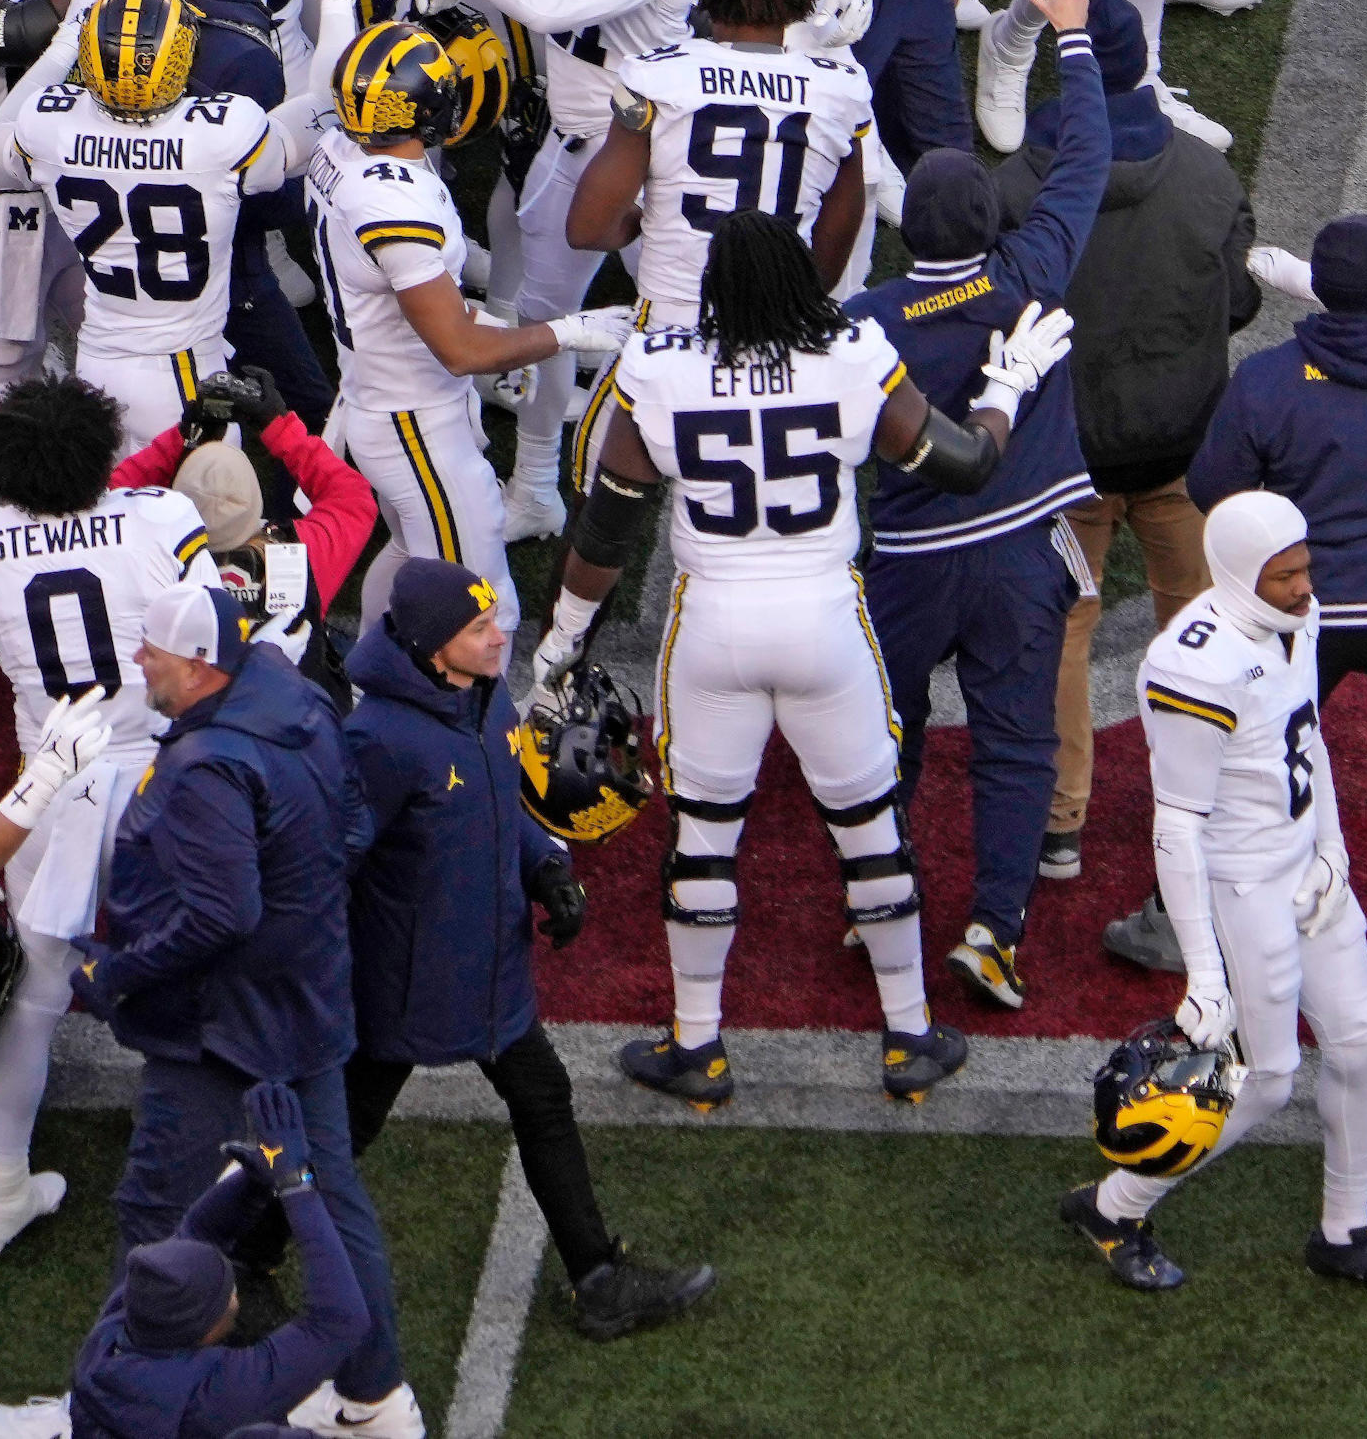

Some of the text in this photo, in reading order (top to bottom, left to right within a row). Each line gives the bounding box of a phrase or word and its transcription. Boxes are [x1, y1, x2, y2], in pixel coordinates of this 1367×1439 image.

[700, 67, 811, 106] BRANDT
[64, 134, 185, 171] JOHNSON
[681, 103, 812, 234] 91
[362, 162, 415, 185] 41
[8, 205, 40, 231] M
[55, 174, 210, 302] 28
[901, 275, 995, 322] MICHIGAN
[711, 361, 797, 398] EFOBI
[672, 401, 843, 539] 55
[467, 576, 499, 612] M
[23, 566, 123, 704] 0
[1177, 619, 1218, 651] 6
